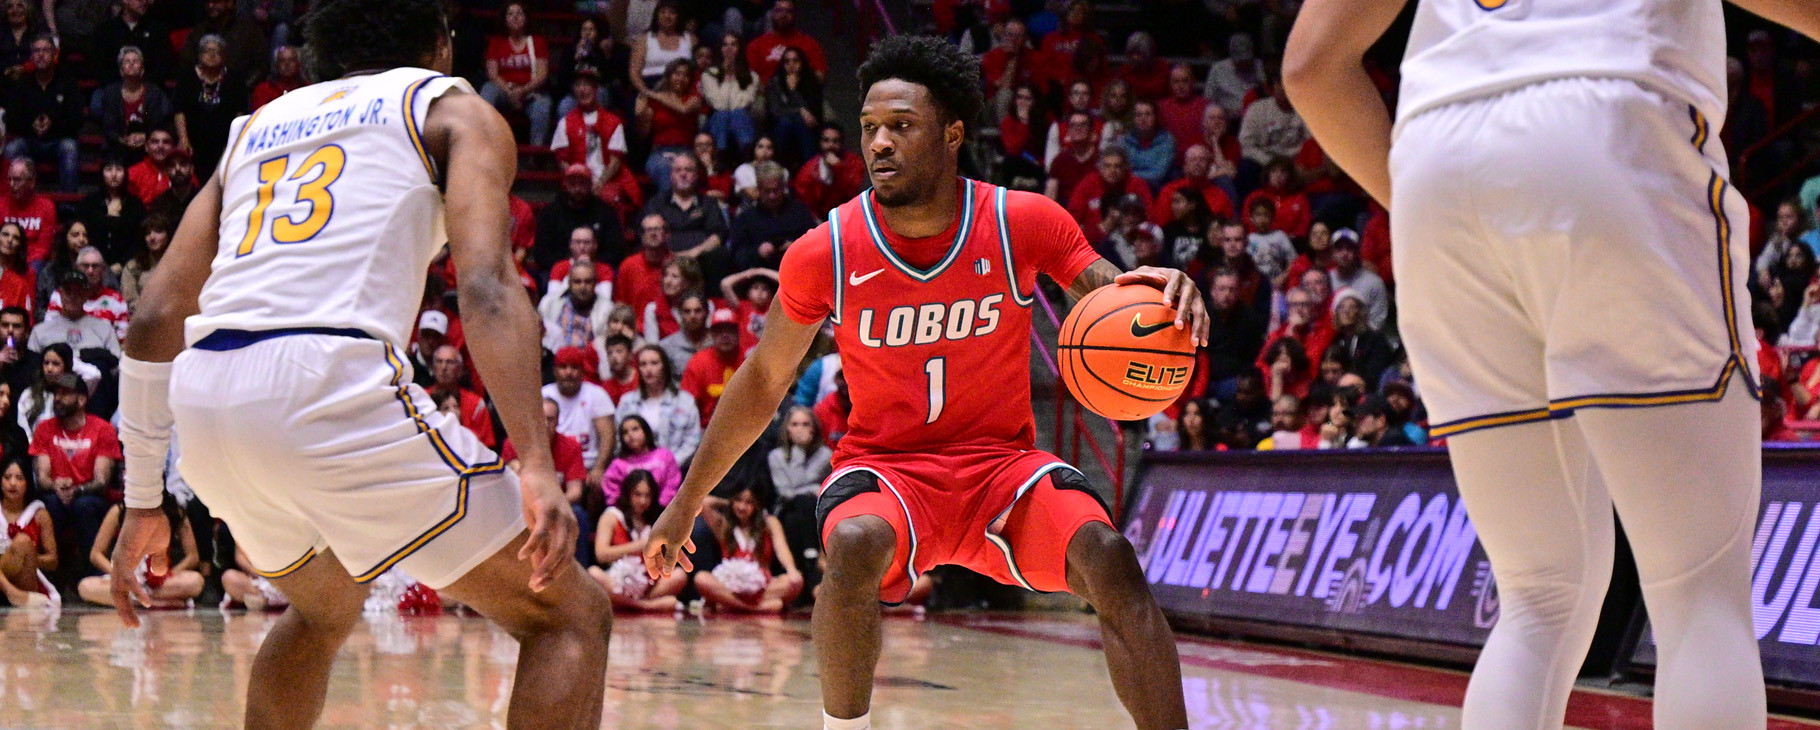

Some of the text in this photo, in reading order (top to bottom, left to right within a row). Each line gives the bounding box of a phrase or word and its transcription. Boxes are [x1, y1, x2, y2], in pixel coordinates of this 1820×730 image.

[245, 98, 387, 154] WASHINGTON JR.
[235, 143, 347, 259] 13
[858, 292, 1005, 348] LOBOS
[924, 356, 946, 424] 1
[1125, 360, 1188, 385] ELITE
